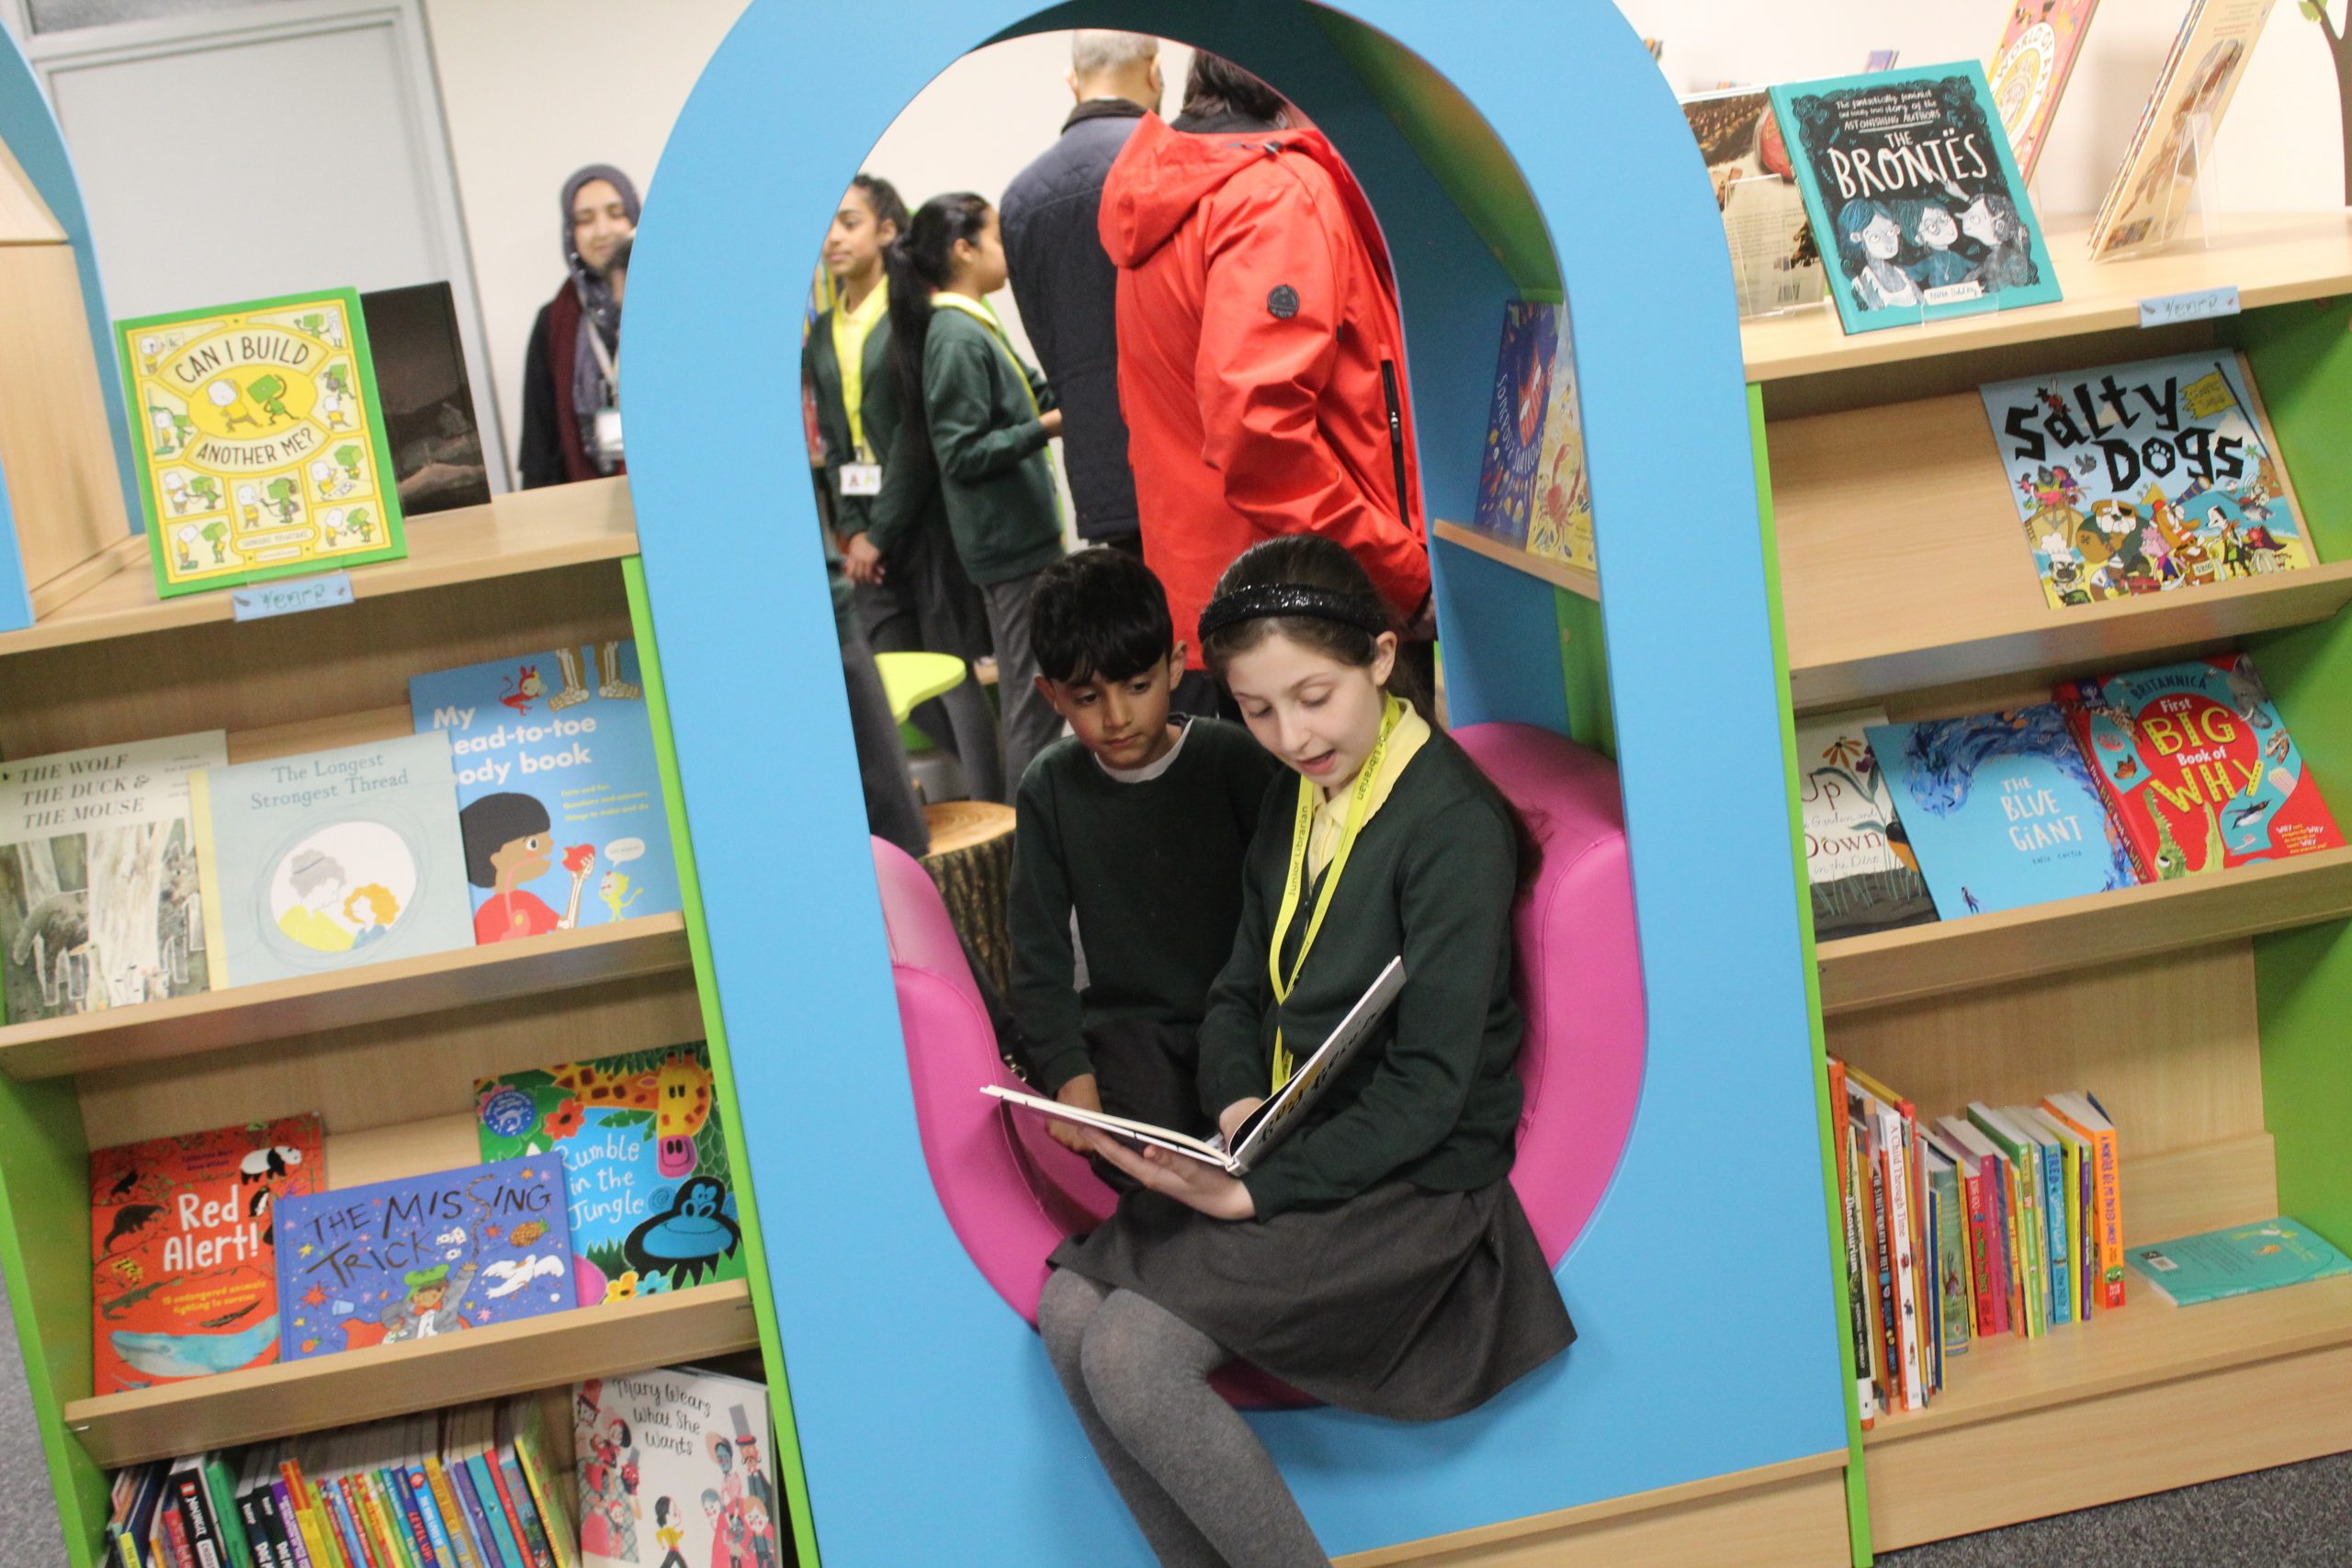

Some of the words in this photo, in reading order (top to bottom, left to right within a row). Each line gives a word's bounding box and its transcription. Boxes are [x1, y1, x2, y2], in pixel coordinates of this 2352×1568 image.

[1997, 28, 2042, 78] WORLD
[1836, 101, 1849, 109] The
[1852, 94, 1898, 109] fantastically
[1901, 89, 1932, 102] feminist
[1885, 104, 1907, 114] story
[1912, 101, 1922, 110] of
[1924, 99, 1937, 108] the
[1844, 117, 1899, 131] ASTONISHING
[1904, 110, 1941, 123] AUTHORS
[1884, 131, 1914, 148] THE
[1826, 128, 1987, 199] BRONTËS
[175, 348, 222, 383] CAN
[227, 341, 233, 360] I
[243, 336, 309, 367] BUILD
[1497, 373, 1514, 460] SOMEBODY
[197, 442, 277, 466] ANOTHER
[283, 427, 315, 454] ME?
[2131, 674, 2206, 700] BRITANNICA
[434, 705, 475, 730] My
[2161, 698, 2192, 714] First
[453, 717, 596, 755] ead-to-toe
[2142, 706, 2236, 756] BIG
[19, 763, 62, 784] THE
[69, 753, 129, 776] WOLF
[272, 766, 307, 784] The
[315, 754, 384, 777] Longest
[458, 758, 511, 784] ody
[520, 743, 592, 774] book
[2177, 750, 2211, 767] Book
[2213, 746, 2227, 760] of
[22, 785, 63, 807] THE
[72, 777, 128, 799] DUCK
[134, 774, 150, 789] &
[251, 787, 338, 810] Strongest
[344, 769, 409, 795] Thread
[1358, 750, 1382, 800] Librarian
[2000, 776, 2032, 794] THE
[2150, 759, 2265, 814] WHY
[24, 808, 65, 829] THE
[72, 797, 145, 822] MOUSE
[2000, 789, 2061, 822] BLUE
[2086, 764, 2103, 786] First
[2096, 784, 2117, 814] BIG
[2109, 813, 2127, 837] Book
[1289, 861, 1301, 896] Junior
[1295, 806, 1308, 858] Librarian
[1890, 1125, 1898, 1134] A
[551, 1134, 640, 1171] Rumble
[1891, 1135, 1901, 1165] Child
[2099, 1143, 2113, 1171] MONSTER
[570, 1178, 591, 1195] in
[597, 1168, 635, 1191] the
[1892, 1167, 1905, 1210] Through
[2101, 1172, 2115, 1184] ATE
[2103, 1186, 2113, 1196] MY
[178, 1184, 239, 1232] Red
[305, 1203, 370, 1245] THE
[382, 1174, 552, 1240] MISSING
[568, 1190, 644, 1231] Jungle
[1897, 1212, 1907, 1236] Time
[164, 1222, 258, 1271] Alert!
[1845, 1195, 1859, 1273] Dinosaurium
[307, 1231, 434, 1288] TRICK
[174, 1287, 228, 1303] endangered
[232, 1280, 266, 1293] animals
[174, 1300, 210, 1315] fighting
[613, 1378, 661, 1406] Mary
[664, 1383, 711, 1417] Wears
[633, 1406, 672, 1428] What
[676, 1411, 700, 1435] She
[645, 1432, 693, 1456] Wants
[407, 1509, 428, 1543] LEVEL
